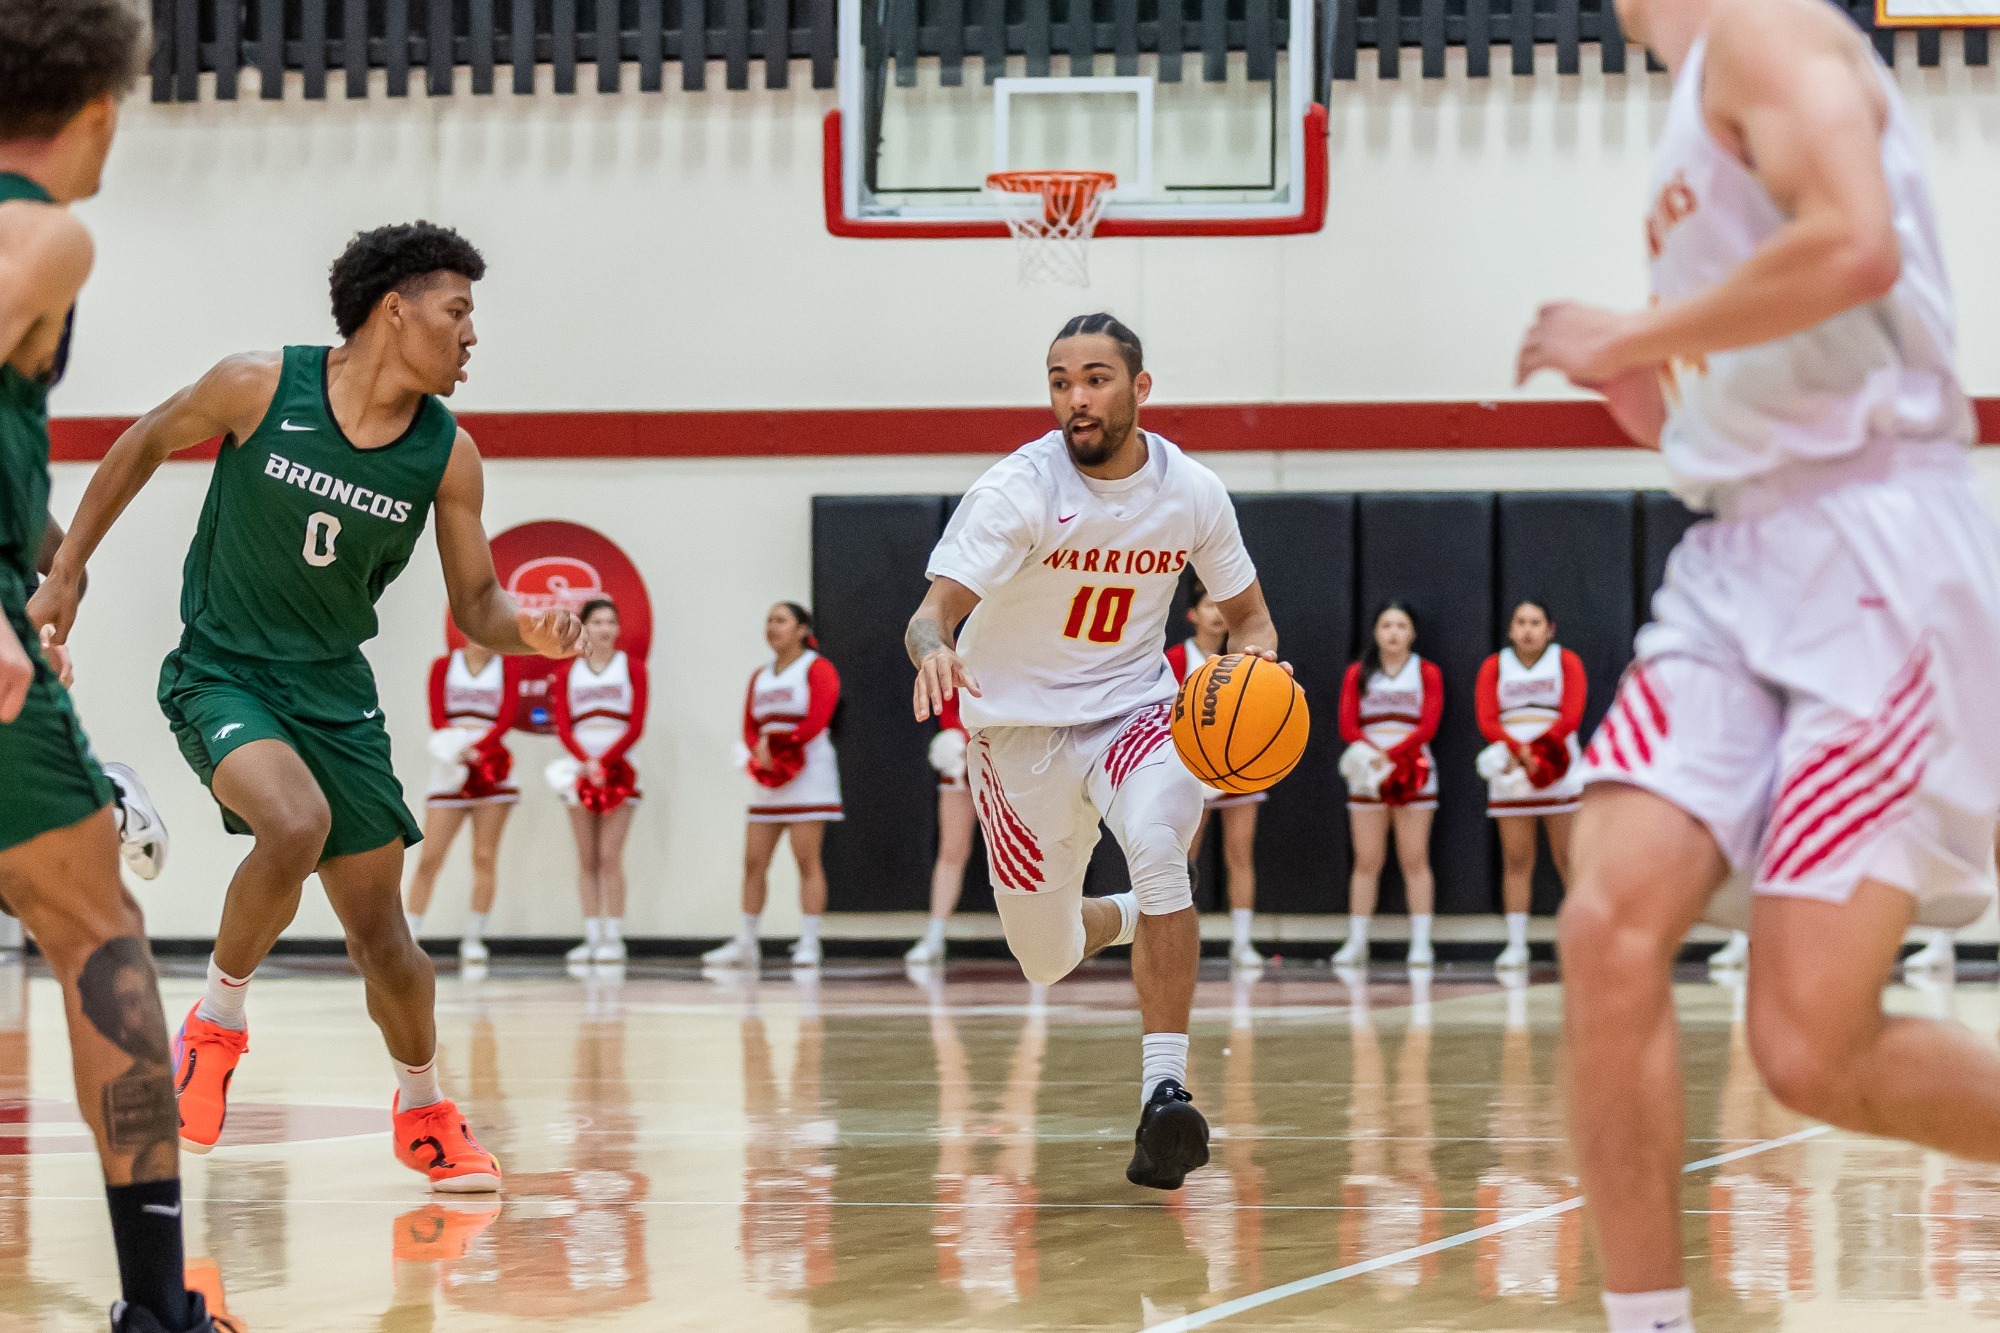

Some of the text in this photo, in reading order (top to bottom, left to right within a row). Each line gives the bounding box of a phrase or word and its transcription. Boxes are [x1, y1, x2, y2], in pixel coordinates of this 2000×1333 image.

[264, 453, 413, 523] BRONCOS
[302, 511, 343, 568] 0
[1062, 584, 1137, 644] 10
